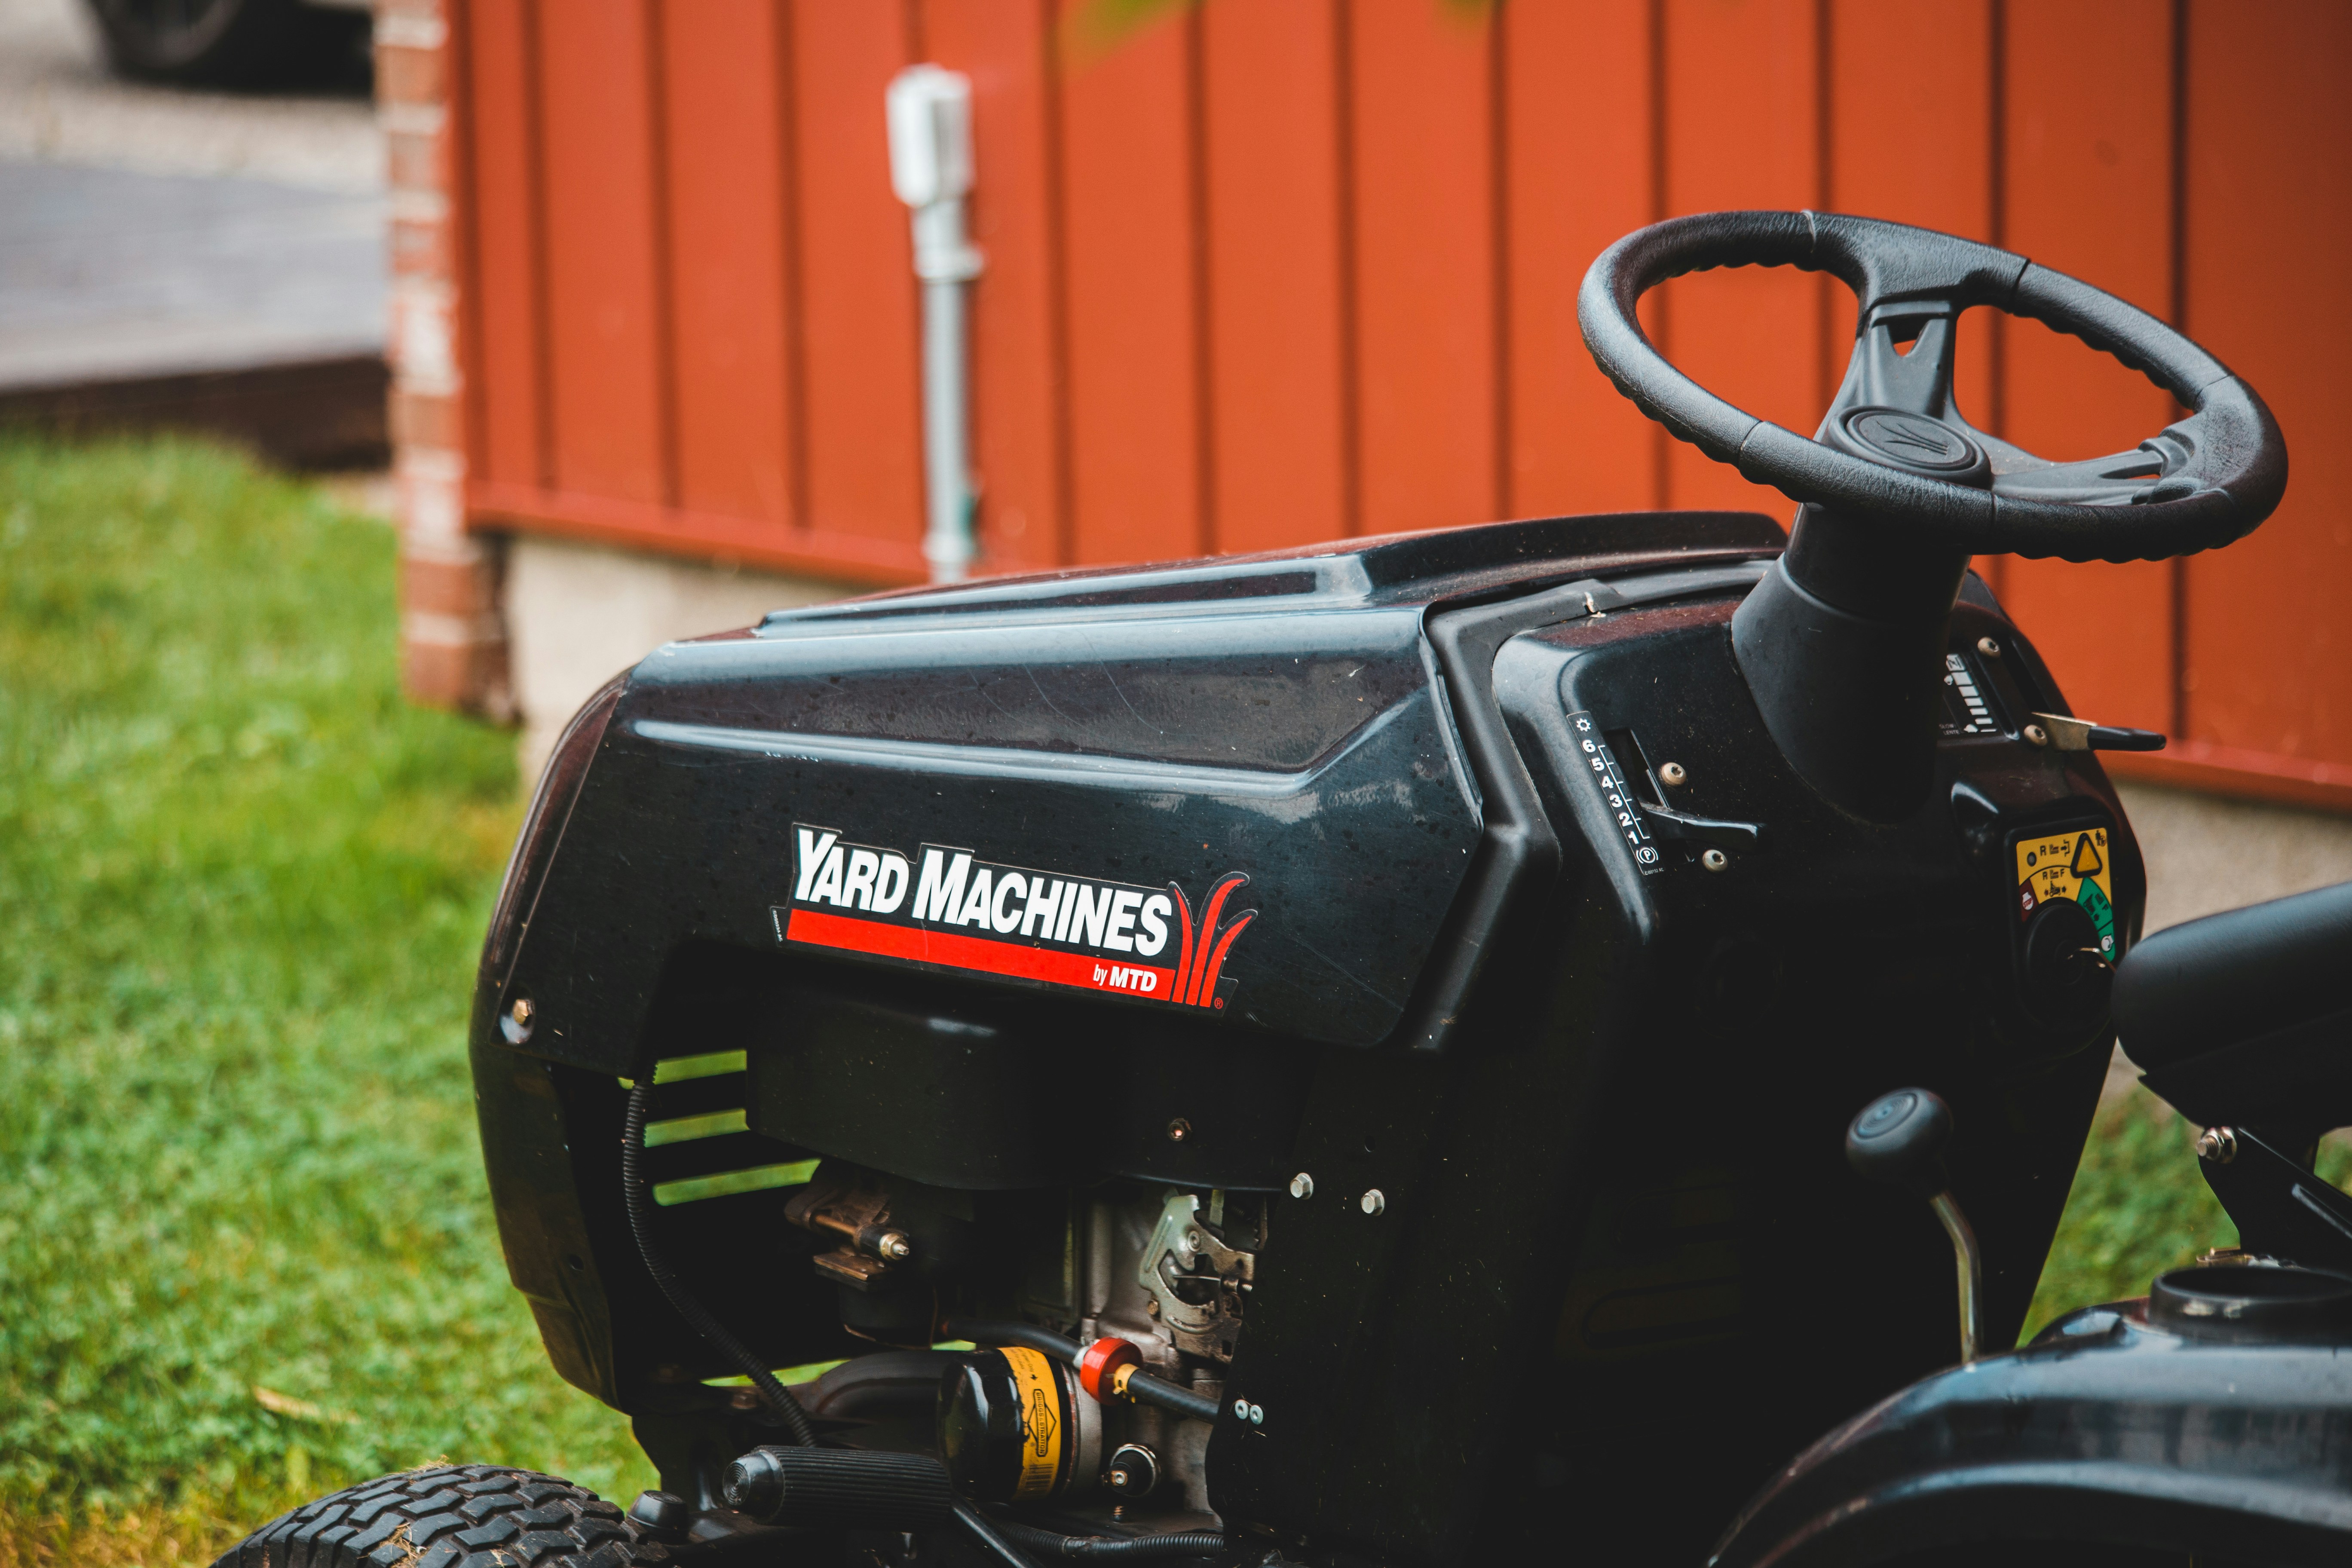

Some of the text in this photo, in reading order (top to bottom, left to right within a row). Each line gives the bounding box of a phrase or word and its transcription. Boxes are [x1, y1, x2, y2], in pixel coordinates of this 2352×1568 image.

[1582, 739, 1596, 753] 6
[1591, 757, 1605, 771] 5
[1601, 775, 1614, 789] 4
[1609, 794, 1623, 808] 3
[1618, 812, 1633, 827] 2
[1628, 831, 1639, 844] 1
[2040, 845, 2046, 856] R
[2042, 868, 2064, 880] R F
[795, 828, 1173, 957] YARD MACHINES
[1093, 964, 1157, 992] by MTD
[1036, 1392, 1044, 1417] BRIGGS
